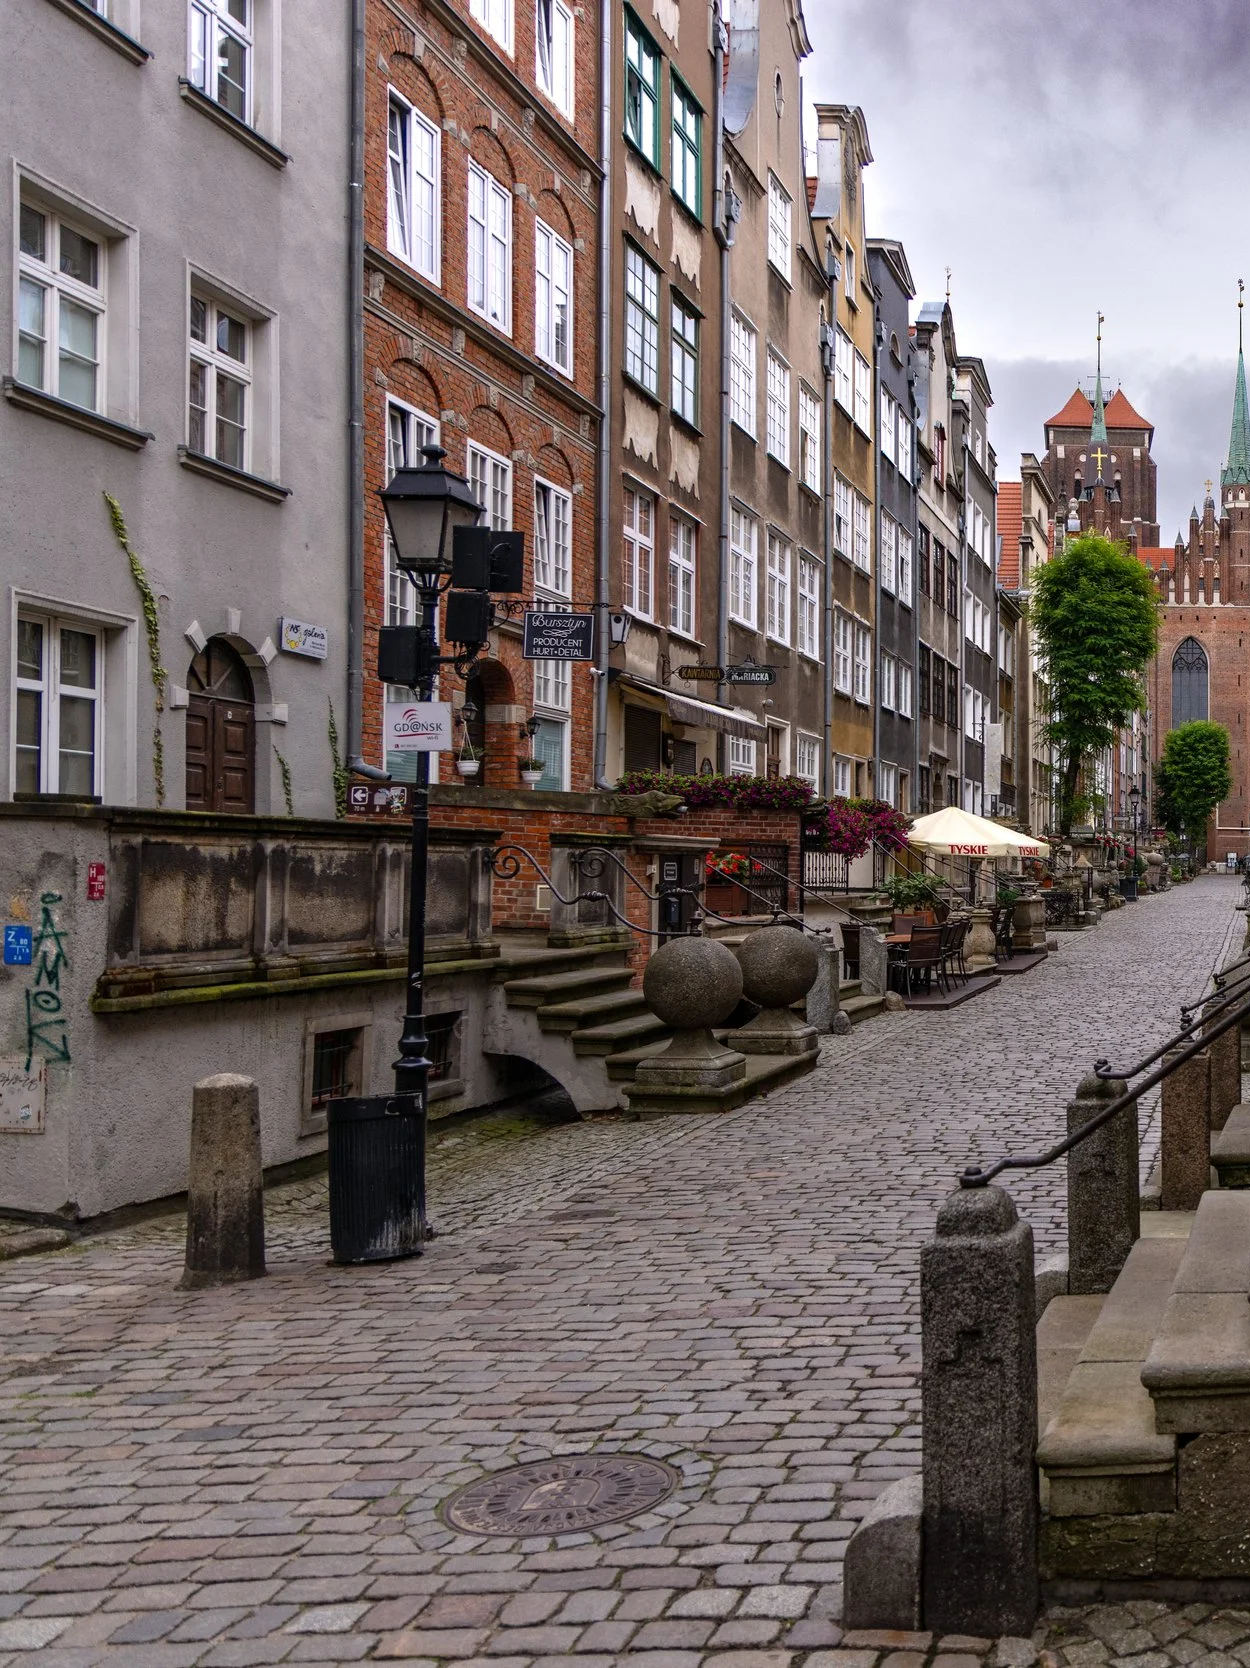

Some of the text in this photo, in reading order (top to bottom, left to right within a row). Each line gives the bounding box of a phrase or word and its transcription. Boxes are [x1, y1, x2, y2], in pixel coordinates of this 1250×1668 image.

[532, 614, 587, 632] Bursztyn
[533, 637, 583, 647] PRODUCENT
[948, 844, 989, 855] TYSKIE
[1018, 846, 1040, 857] TYSKIE
[90, 867, 97, 878] H
[7, 930, 16, 942] Z
